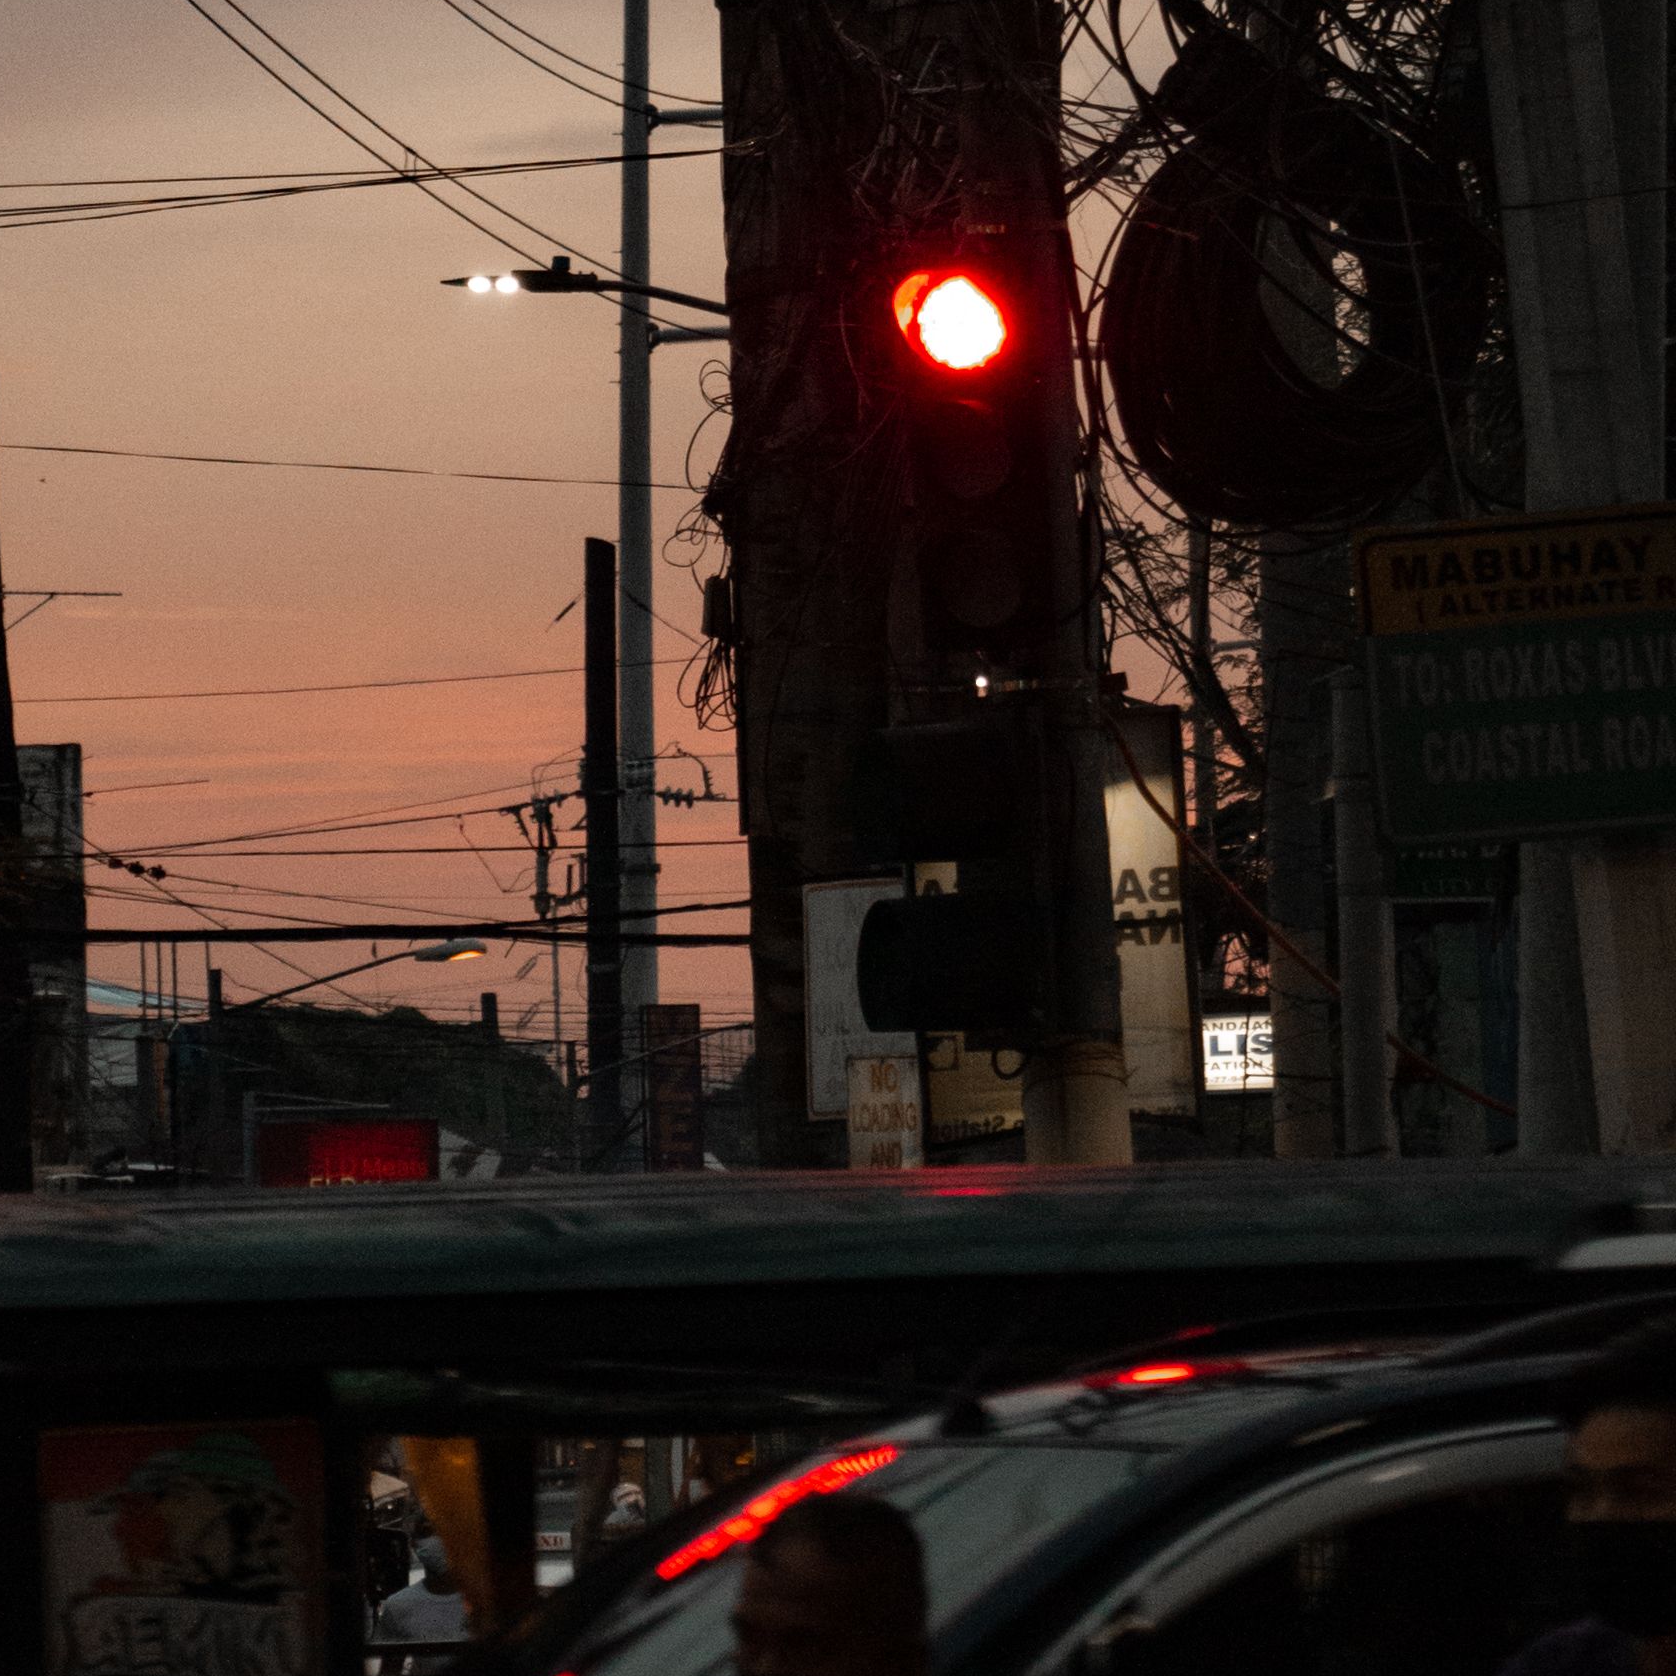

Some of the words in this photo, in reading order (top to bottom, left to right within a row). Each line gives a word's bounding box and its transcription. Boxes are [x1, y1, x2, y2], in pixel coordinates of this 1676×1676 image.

[1390, 534, 1653, 590] MABUHAY
[1391, 652, 1454, 707] TO:
[1463, 640, 1588, 701] ROXAS
[1599, 633, 1676, 692] BLV
[1422, 719, 1591, 785] COASTAL
[870, 1063, 897, 1092] NO
[851, 1102, 918, 1132] LOADING
